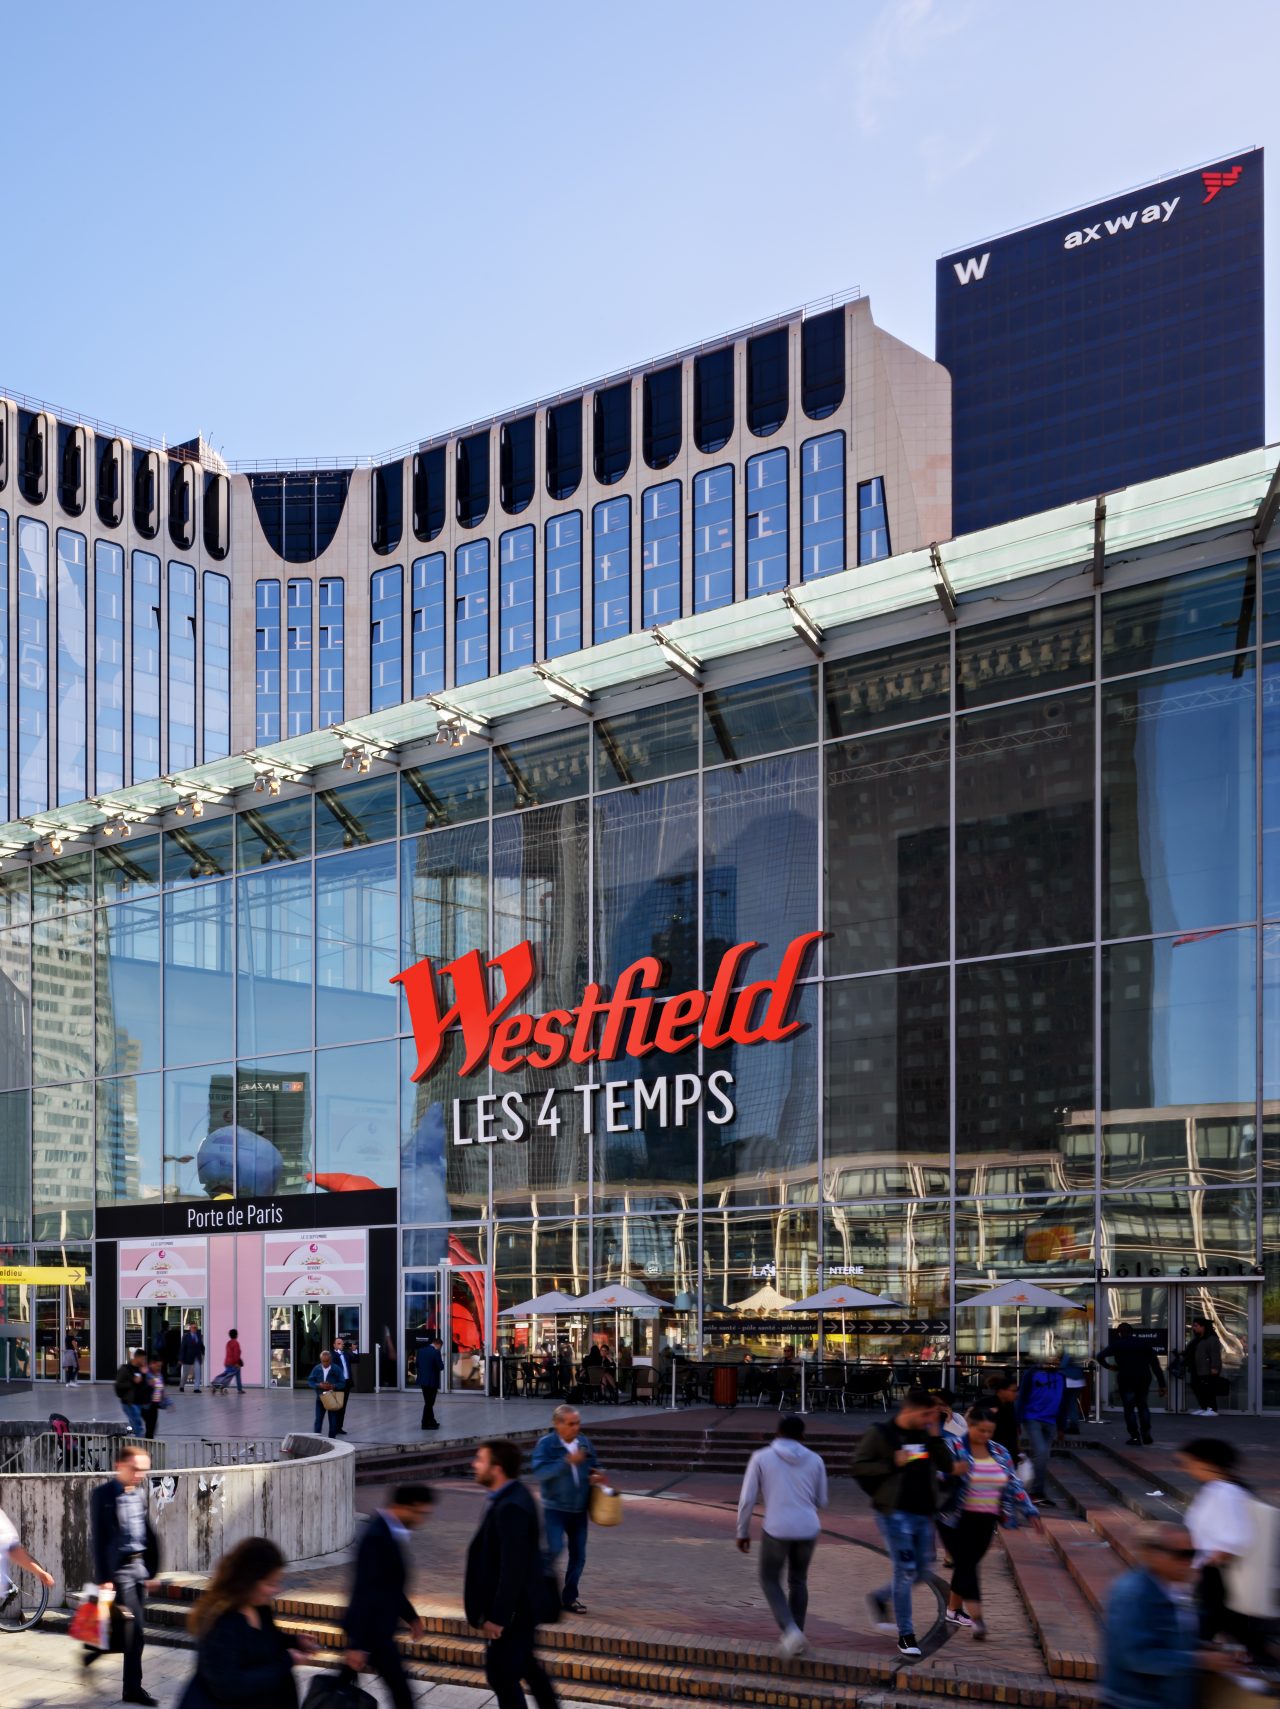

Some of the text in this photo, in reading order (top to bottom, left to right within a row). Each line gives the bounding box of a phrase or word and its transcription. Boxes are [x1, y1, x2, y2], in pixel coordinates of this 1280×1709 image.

[1063, 196, 1181, 249] axway
[953, 253, 991, 286] W
[389, 931, 825, 1083] Westfield
[453, 1069, 736, 1146] LES 4 TEMPS
[188, 1204, 283, 1228] Porte de Paris
[1095, 1261, 1267, 1282] pôle santé
